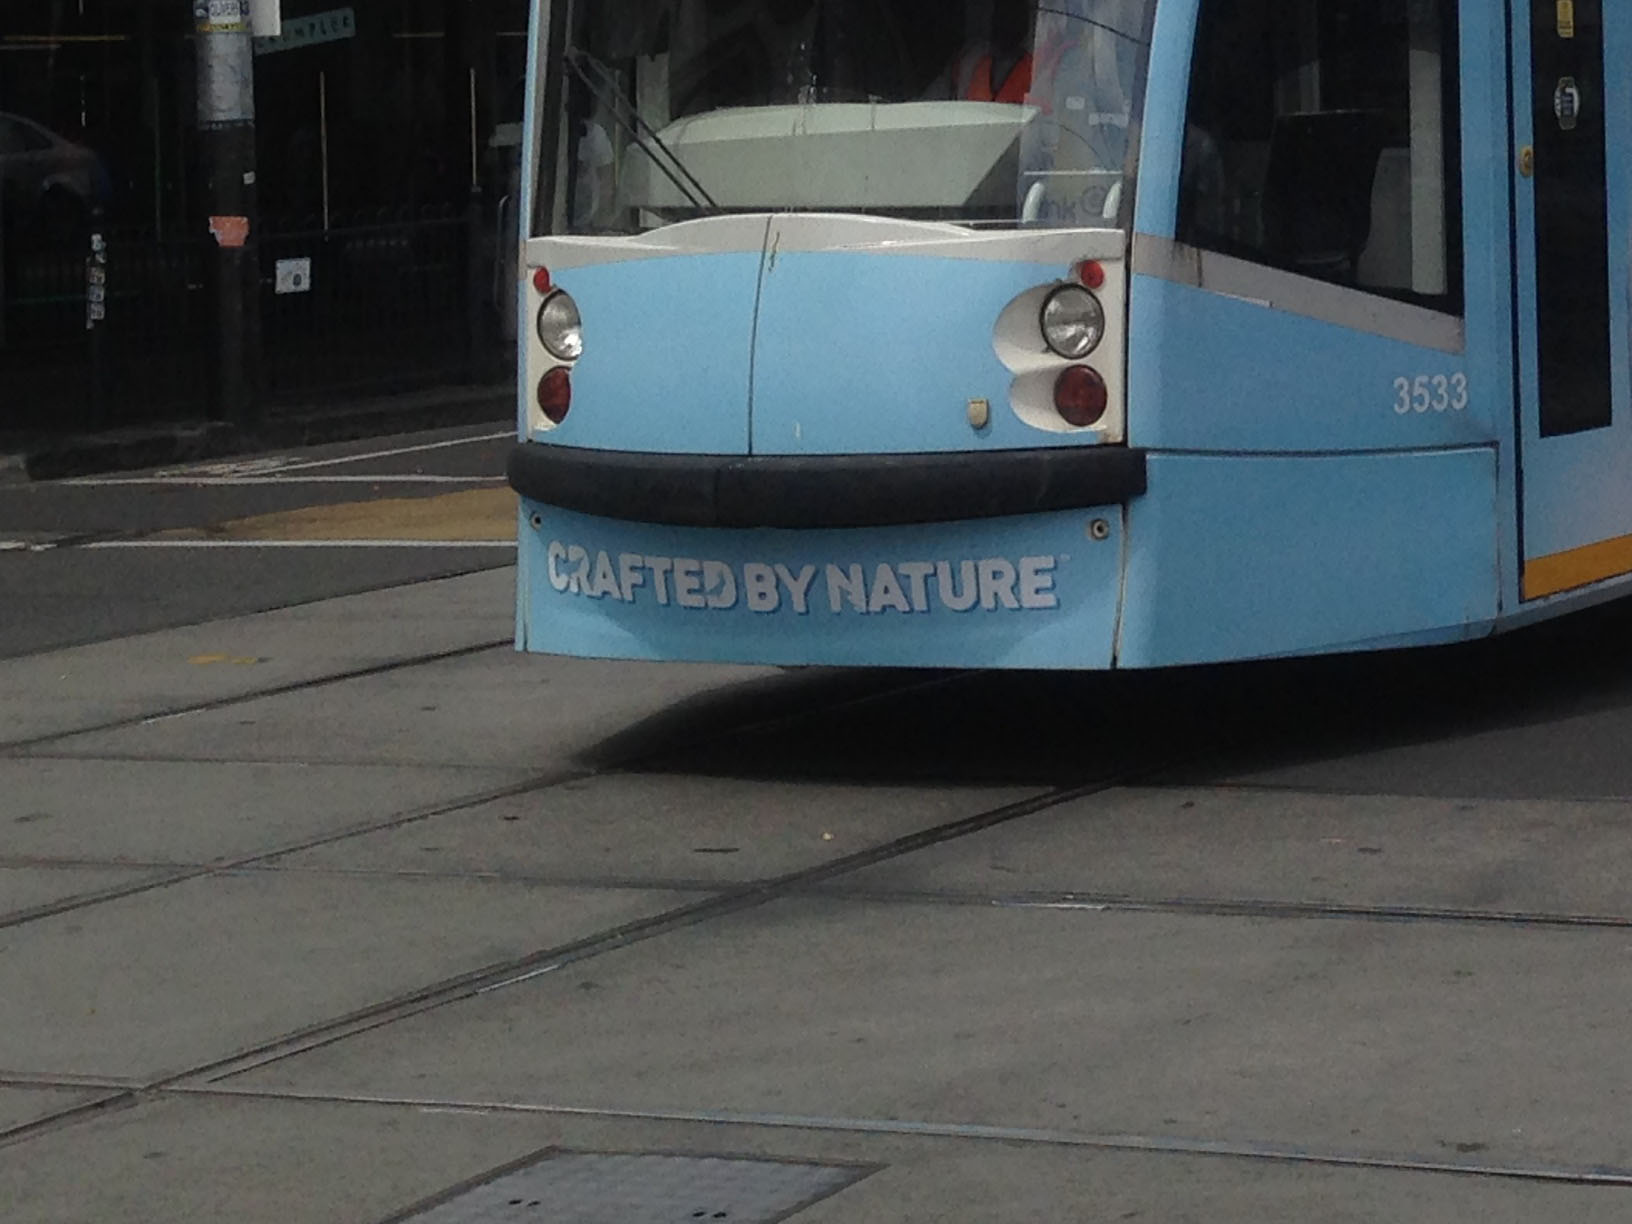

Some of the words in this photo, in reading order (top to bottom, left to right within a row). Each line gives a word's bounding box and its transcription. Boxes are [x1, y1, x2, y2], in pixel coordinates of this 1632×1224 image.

[1393, 372, 1468, 414] 3533
[547, 540, 738, 610] CRAFTED
[744, 561, 820, 614] BY
[824, 554, 1060, 614] NATURE
